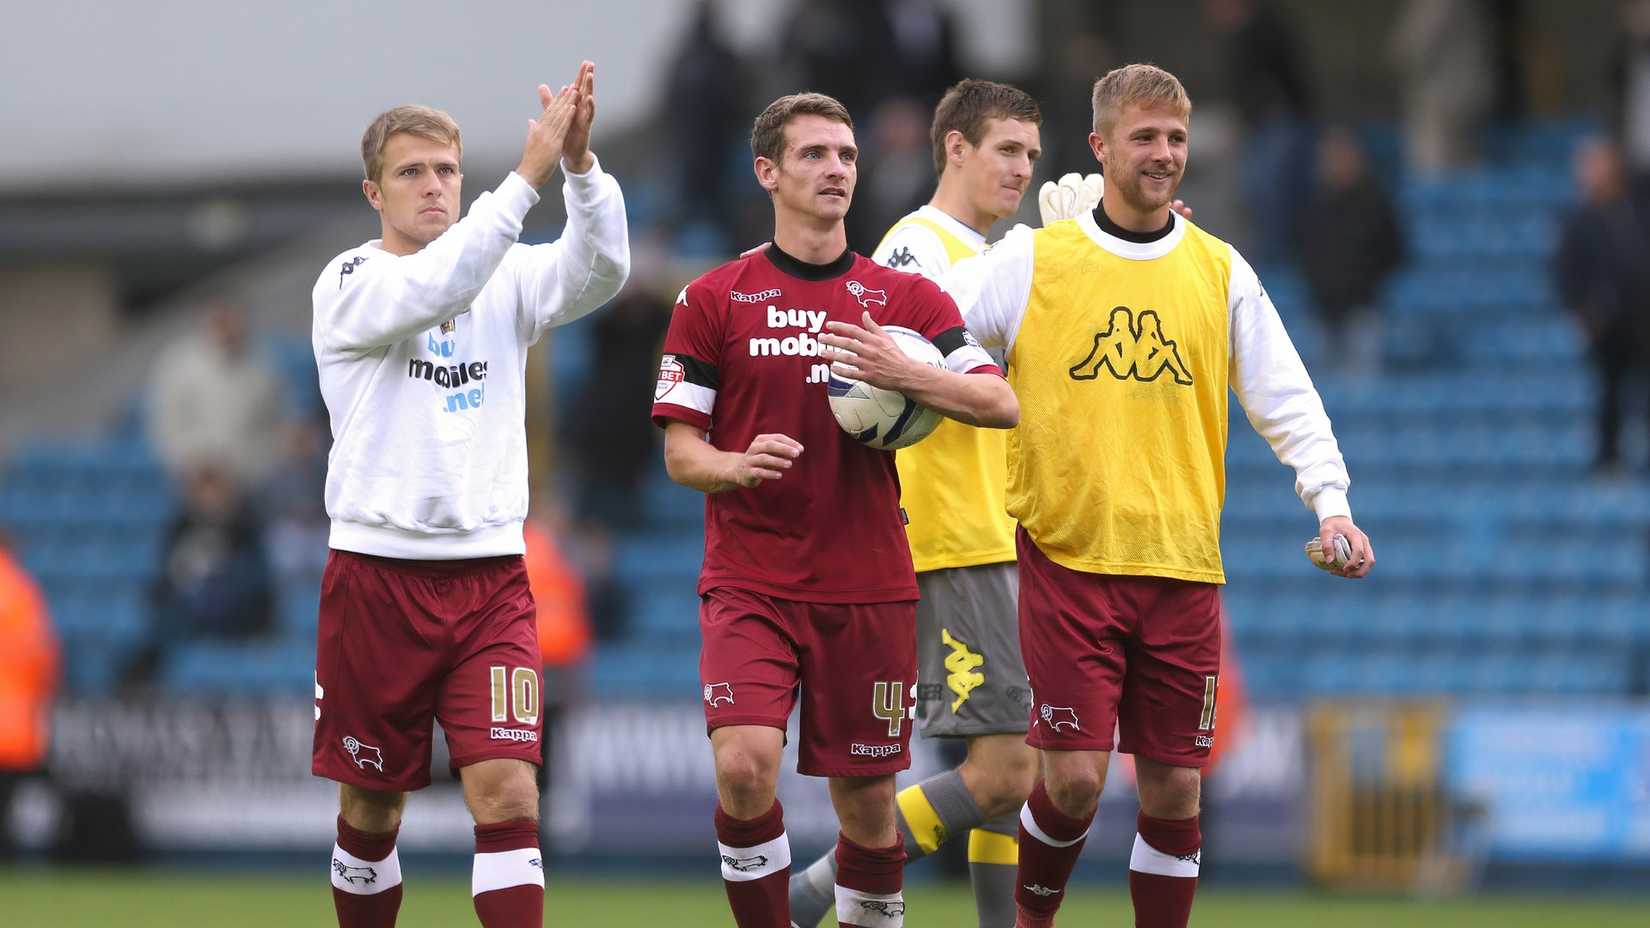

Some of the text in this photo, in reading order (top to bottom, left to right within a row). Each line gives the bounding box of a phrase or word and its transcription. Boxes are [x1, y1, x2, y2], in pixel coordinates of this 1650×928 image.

[730, 288, 782, 303] Kappa
[767, 305, 827, 333] buy
[428, 331, 456, 358] bu
[805, 363, 830, 384] .n
[443, 381, 485, 413] .ne
[490, 666, 539, 725] 10
[1199, 676, 1219, 729] 1
[873, 682, 905, 737] 4
[491, 727, 538, 742] Kappa
[850, 743, 902, 758] Kappa
